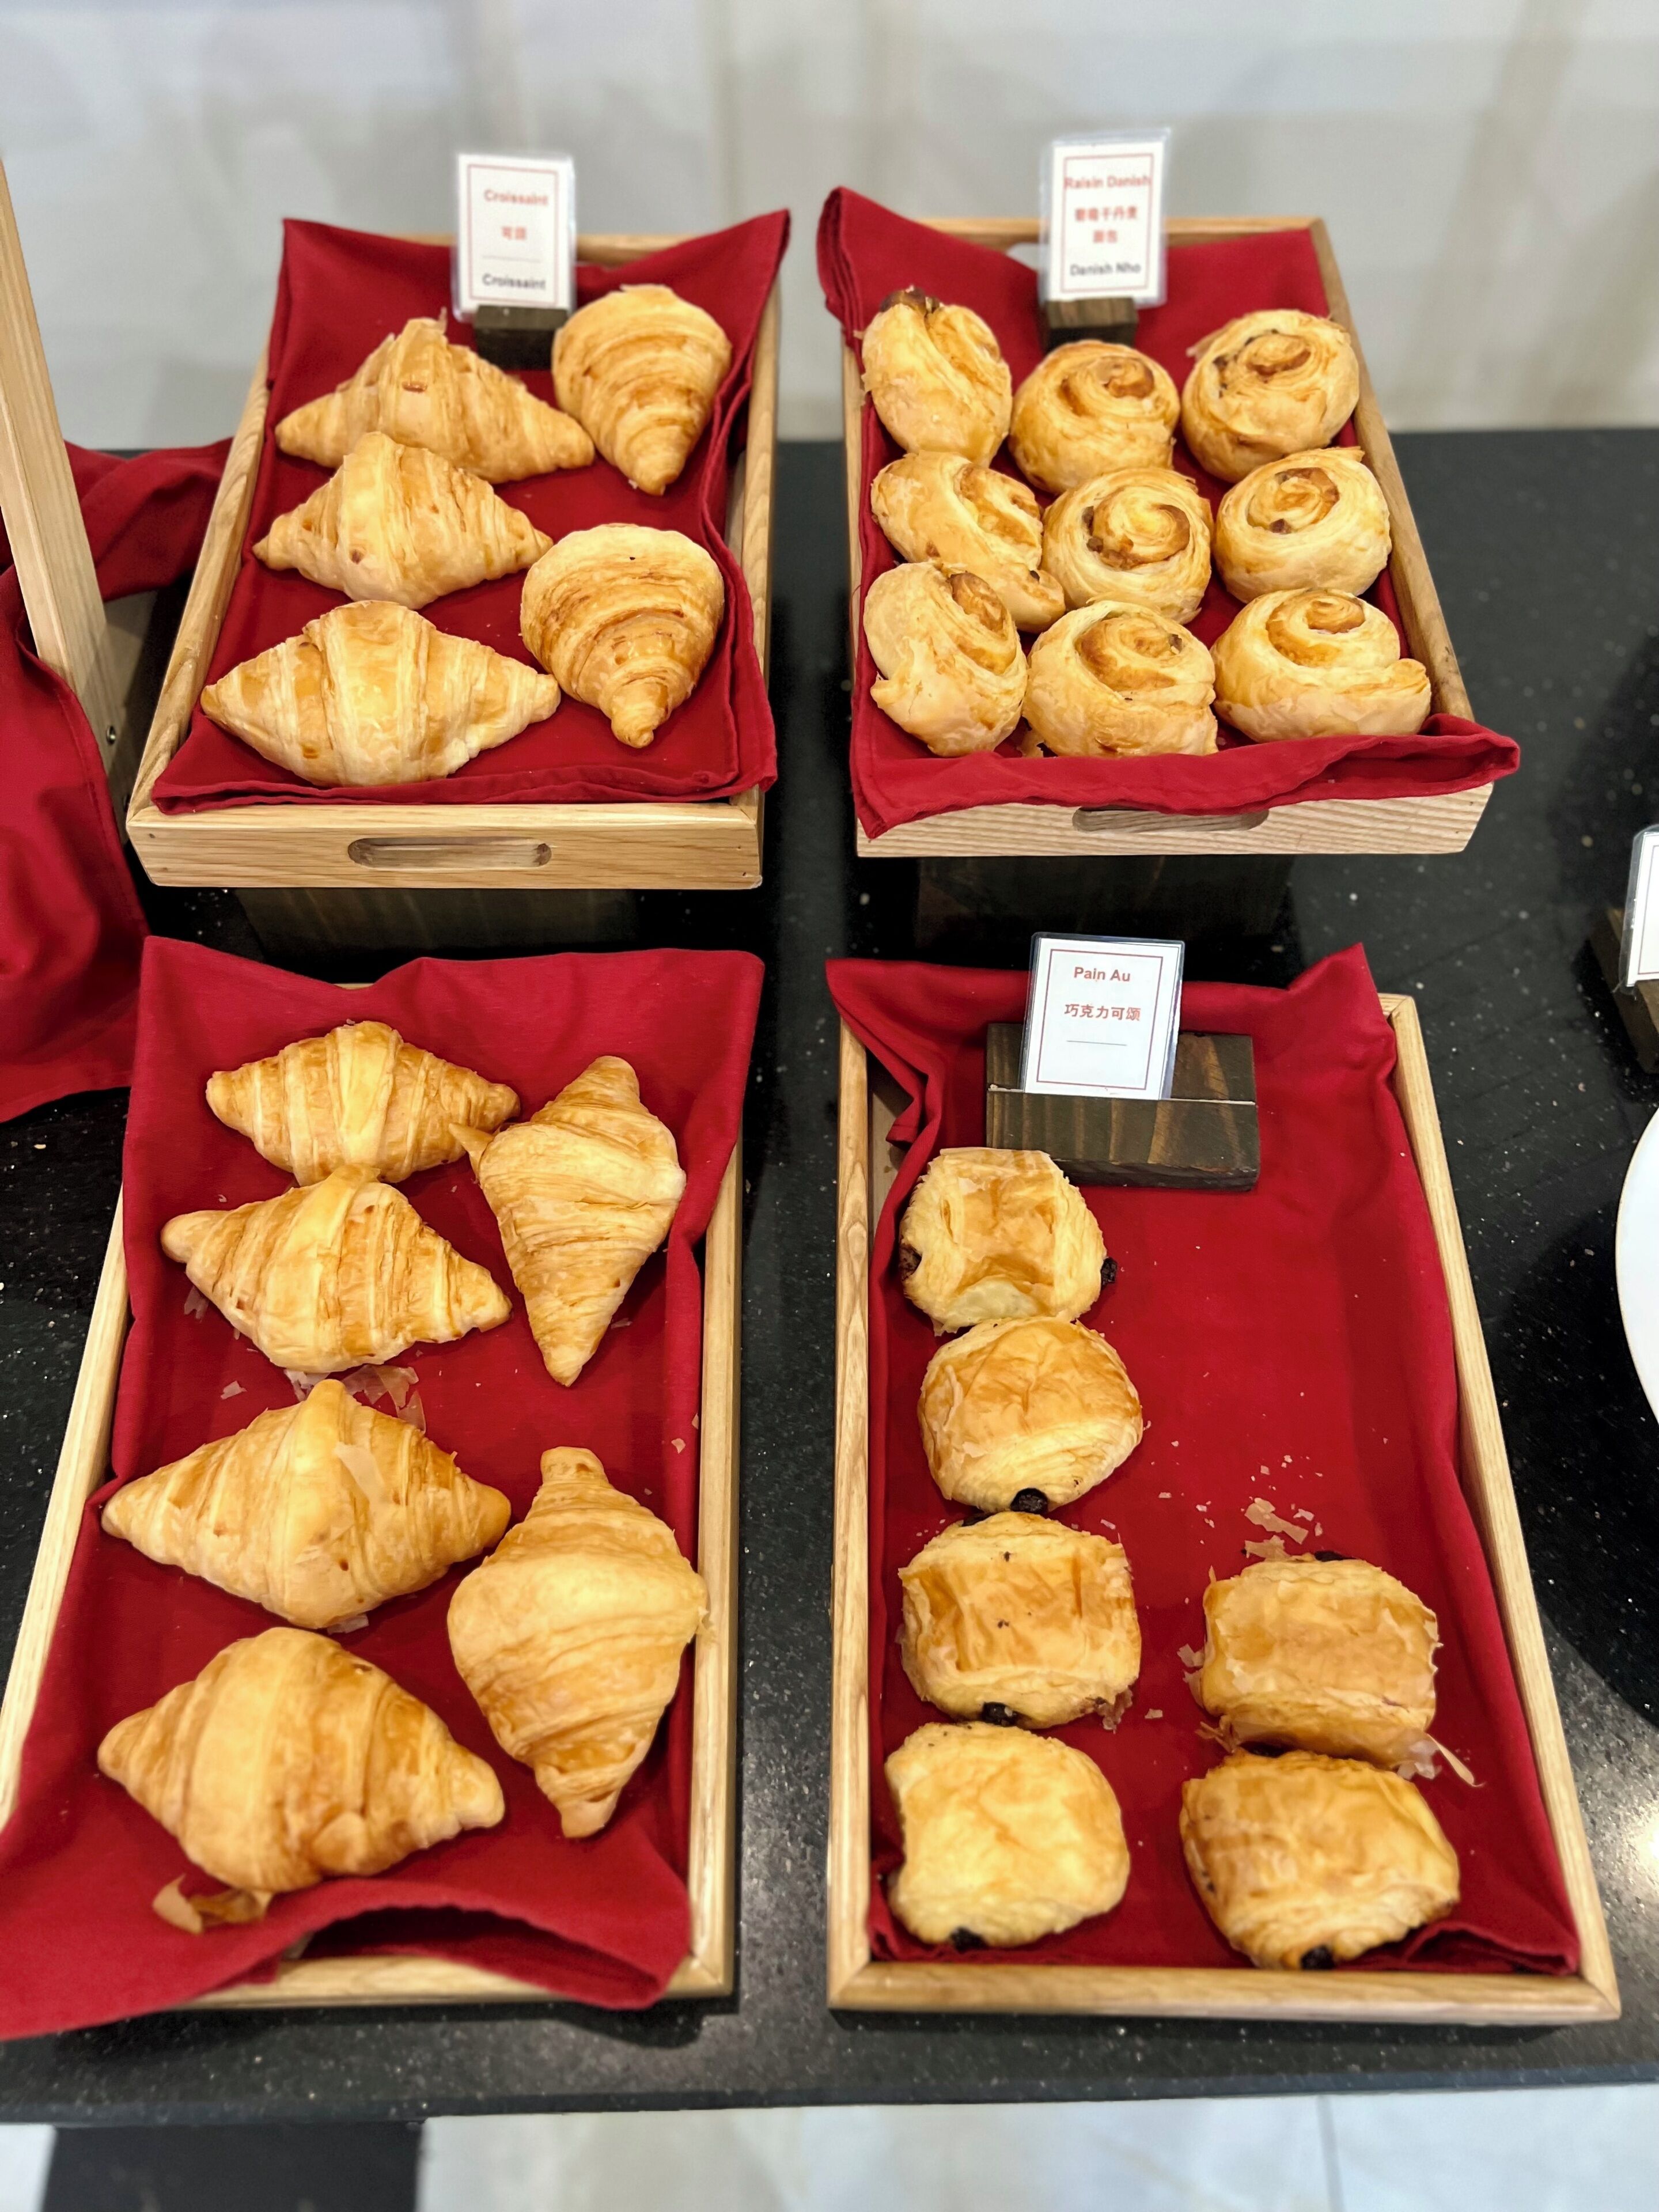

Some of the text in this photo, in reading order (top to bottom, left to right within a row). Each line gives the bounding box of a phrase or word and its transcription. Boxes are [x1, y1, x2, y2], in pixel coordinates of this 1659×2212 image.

[1107, 175, 1151, 188] Danish
[1070, 262, 1142, 276] Danish Nho
[1074, 967, 1131, 982] Pain Au
[1064, 1003, 1141, 1021] 巧克力可颂
